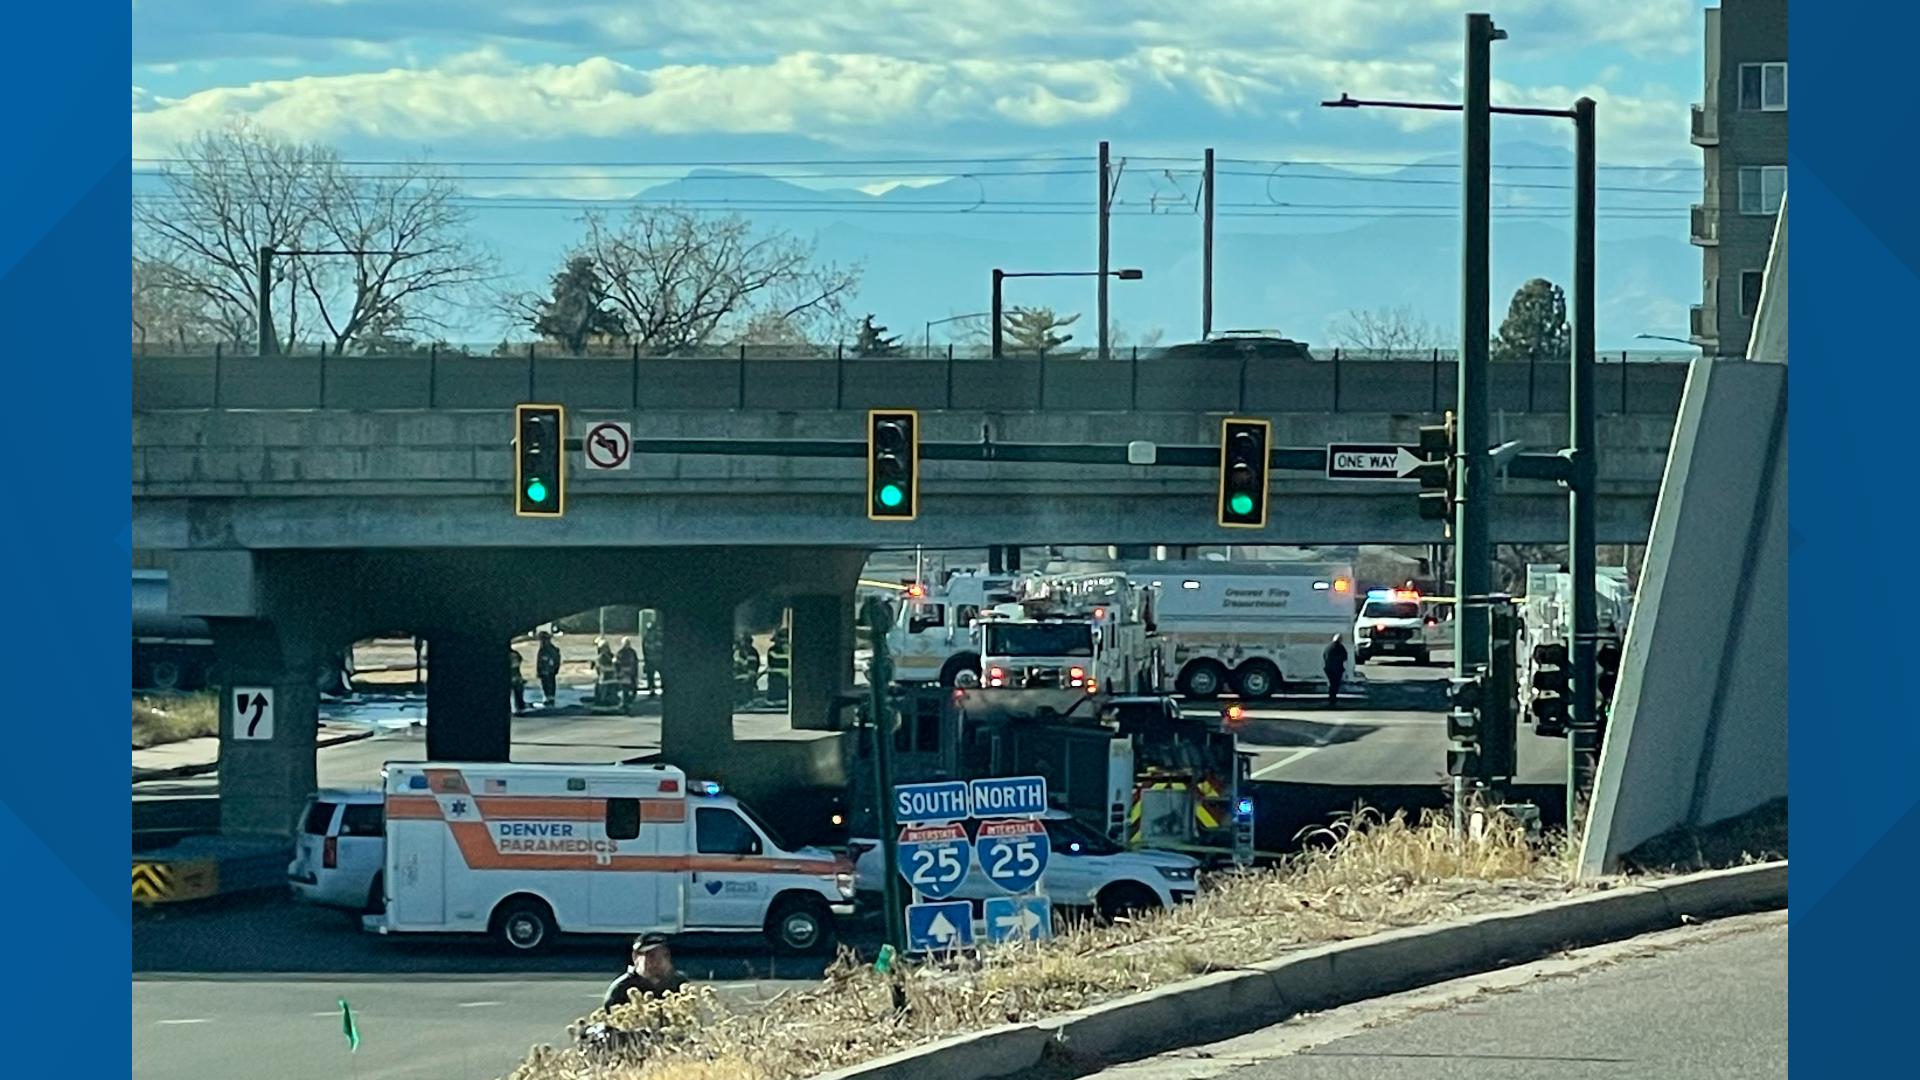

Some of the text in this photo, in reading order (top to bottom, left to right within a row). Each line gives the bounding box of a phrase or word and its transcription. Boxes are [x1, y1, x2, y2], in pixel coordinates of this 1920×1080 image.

[1338, 454, 1397, 468] ONE WAY
[899, 789, 964, 815] SOUTH
[975, 784, 1041, 809] NORTH
[500, 823, 573, 837] DENVER
[908, 829, 956, 842] INTERSTATE
[987, 823, 1034, 835] INTERSTATE
[500, 839, 618, 853] PARAMEDICS
[912, 847, 961, 884] 25
[990, 842, 1040, 878] 25
